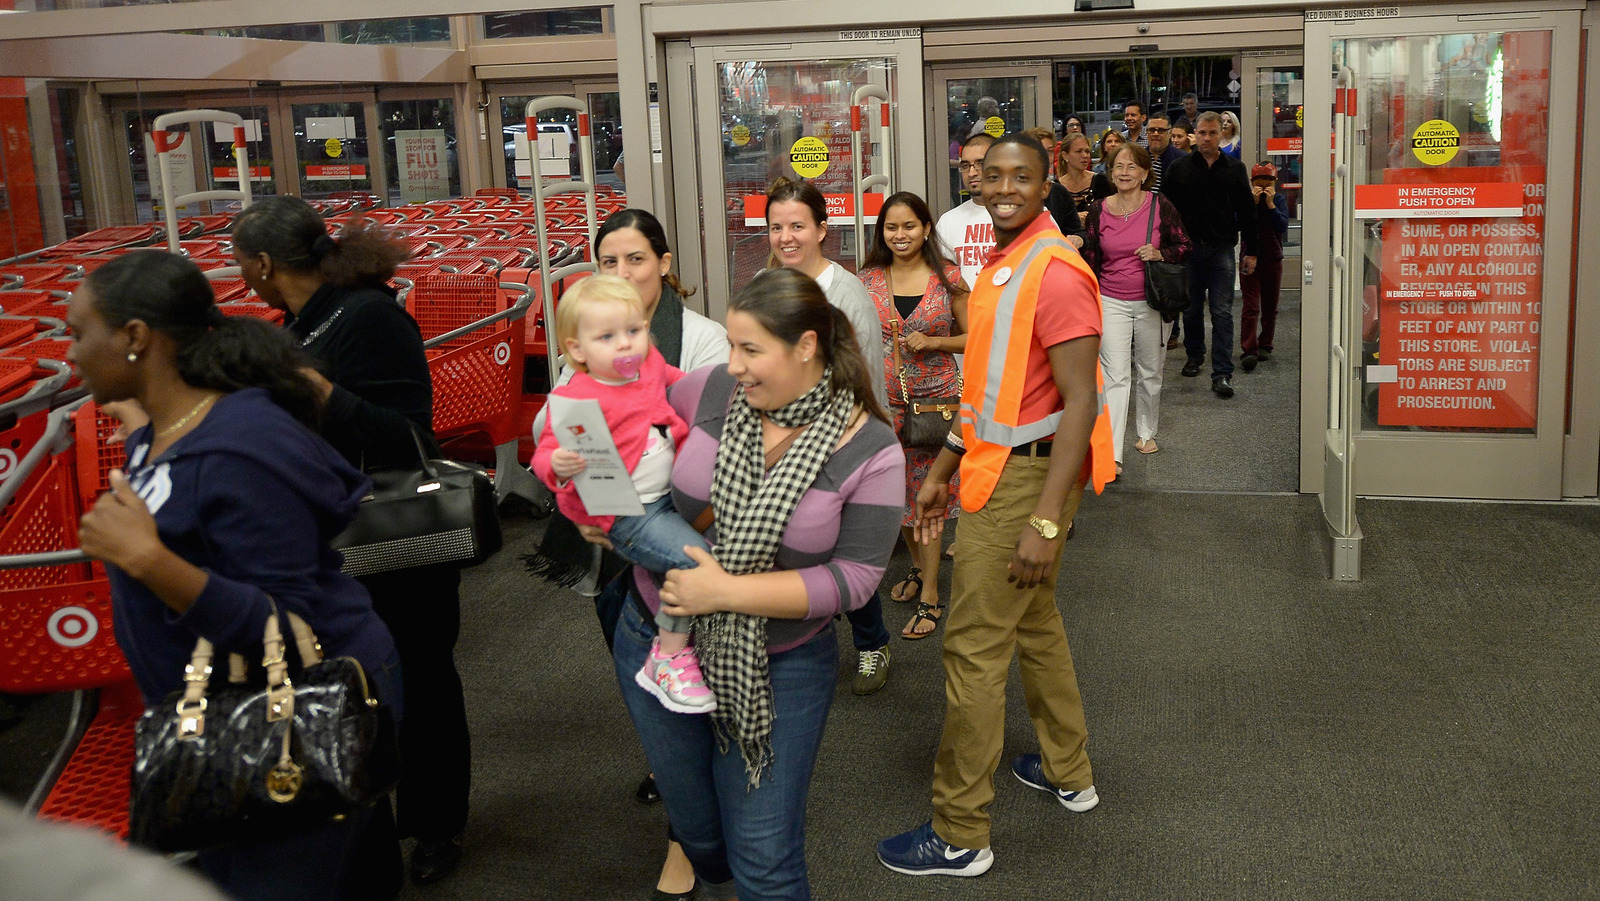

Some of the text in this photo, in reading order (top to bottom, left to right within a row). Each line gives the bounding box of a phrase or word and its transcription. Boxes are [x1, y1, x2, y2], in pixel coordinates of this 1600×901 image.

[1320, 10, 1343, 19] DURING
[1344, 9, 1375, 18] BUSINESS
[1376, 8, 1398, 16] HOURS
[902, 28, 920, 37] UNLOC
[1415, 138, 1457, 147] CAUTION
[406, 152, 438, 168] FLU
[408, 170, 439, 180] SHOTS
[1411, 187, 1476, 196] EMERGENCY
[1400, 198, 1475, 207] PUSH TO OPEN
[1401, 223, 1540, 239] SUME, OR POSSESS,
[954, 245, 994, 267] TEN
[1401, 243, 1543, 257] IN AN OPEN CONTAIN
[1401, 262, 1536, 278] ER, ANY ALCOHOLIC
[1495, 282, 1527, 295] THIS
[1400, 302, 1541, 314] STORE OR WITHIN 10
[1400, 320, 1432, 333] FEET
[1435, 321, 1454, 333] OF
[1457, 321, 1486, 334] ANY
[1490, 321, 1526, 334] PART
[1399, 340, 1537, 353] THIS STORE. VIOLA-
[1398, 358, 1532, 372] TORS ARE SUBJECT
[1398, 377, 1506, 390] TO ARREST AND
[1398, 396, 1496, 410] PROSECUTION.
